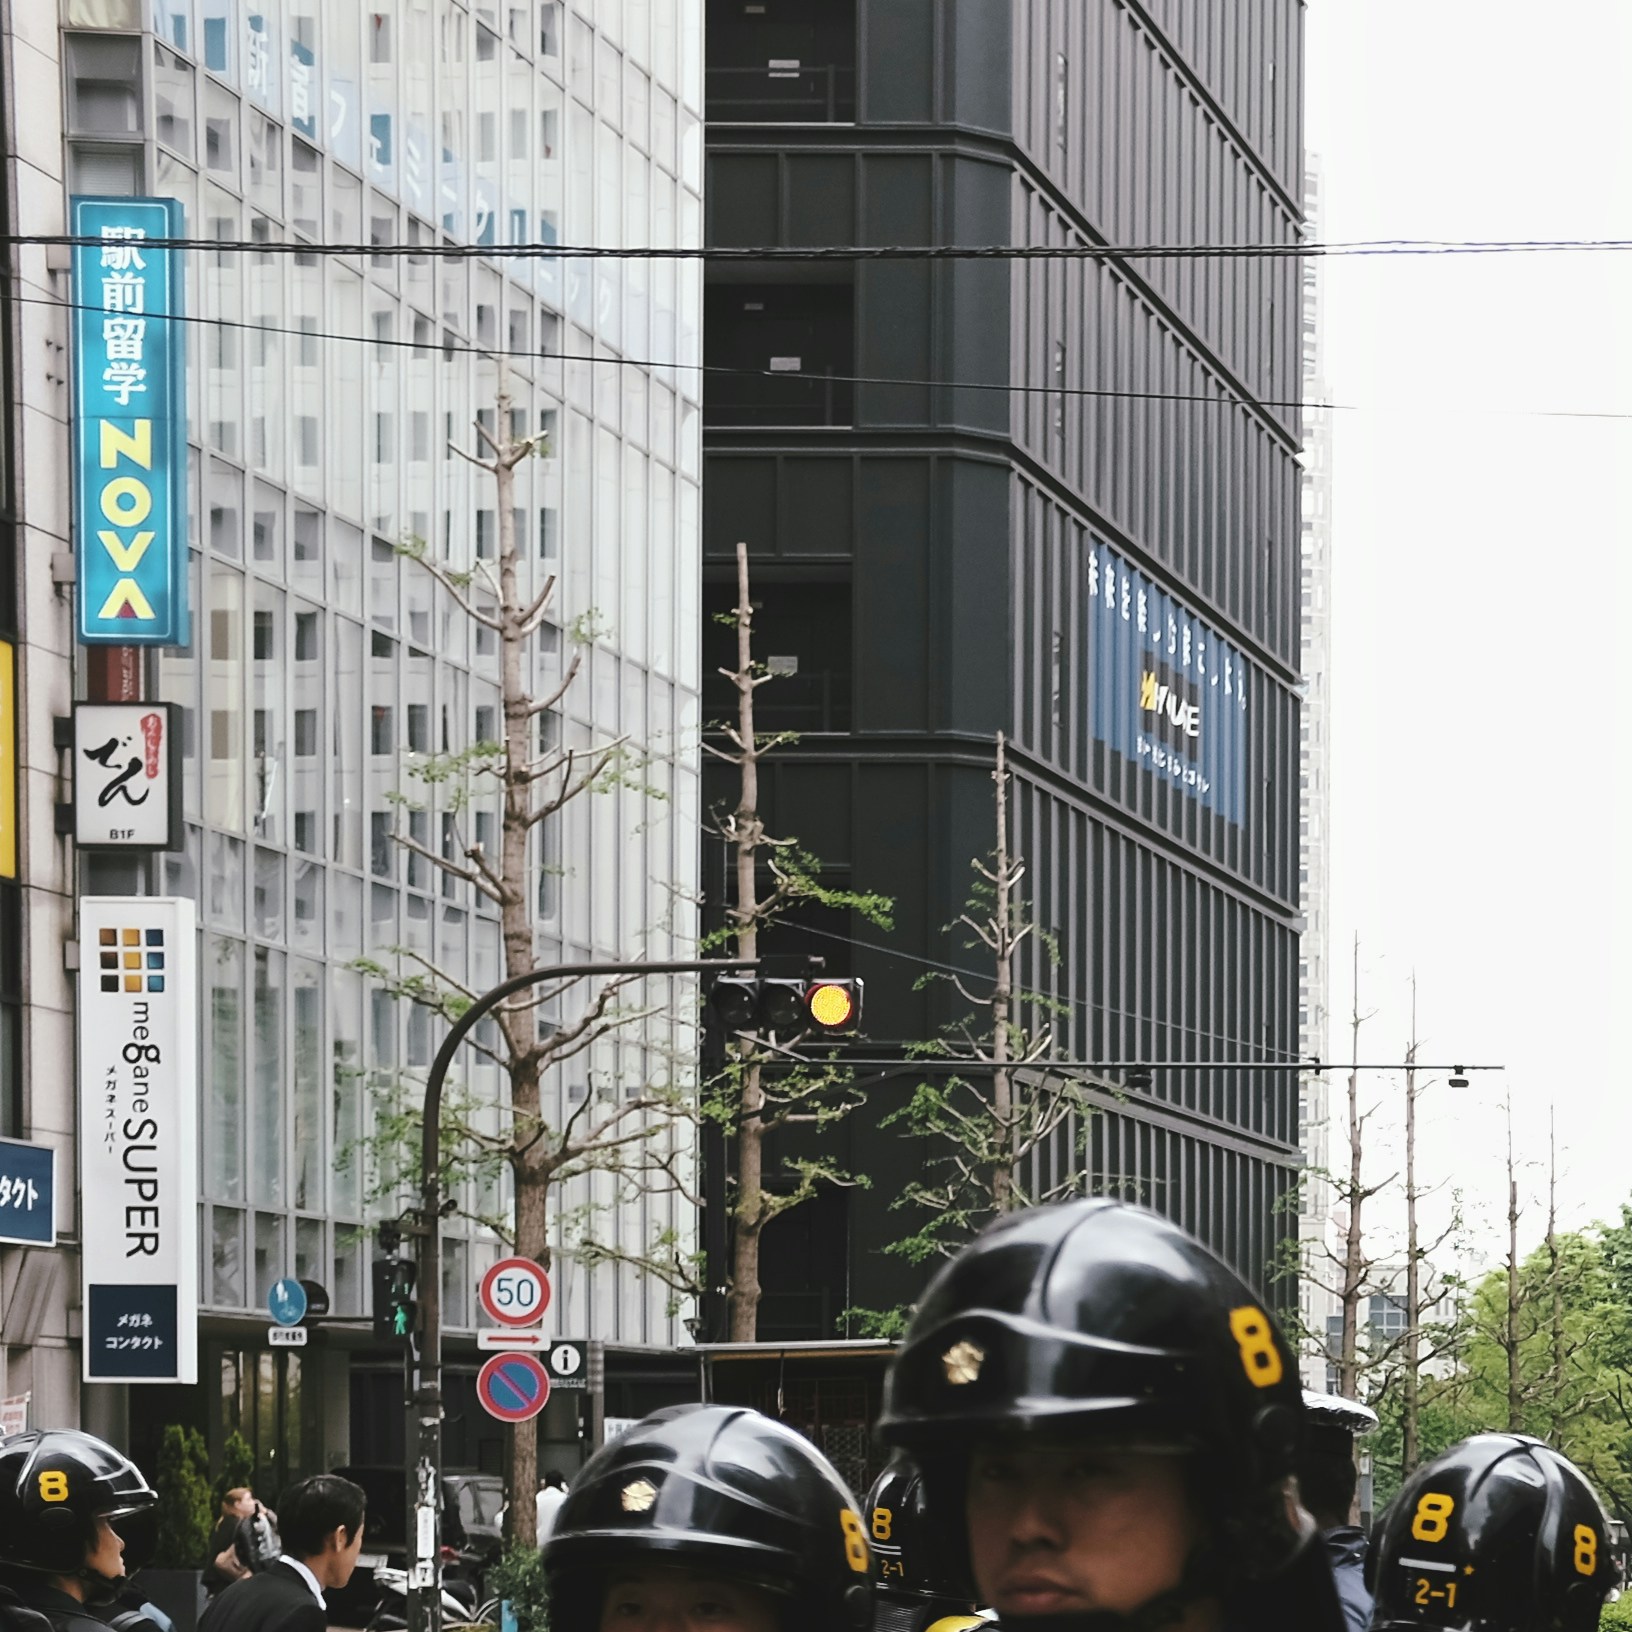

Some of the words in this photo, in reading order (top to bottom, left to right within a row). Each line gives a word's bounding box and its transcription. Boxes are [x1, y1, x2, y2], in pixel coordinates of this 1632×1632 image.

[100, 226, 147, 406] 駅前留学
[97, 418, 156, 619] NOVA
[110, 830, 135, 839] B1F
[104, 1065, 118, 1154] メガネスーパー
[497, 1277, 535, 1307] 50
[117, 1313, 153, 1328] メガネ
[105, 1336, 163, 1350] コンタクト
[1228, 1305, 1283, 1388] 8
[38, 1470, 69, 1502] 8
[873, 1507, 892, 1541] 8
[1411, 1492, 1455, 1543] 8
[840, 1507, 869, 1573] 8
[1573, 1523, 1598, 1576] 8
[881, 1559, 905, 1577] 2-1
[1414, 1578, 1457, 1608] 2-1
